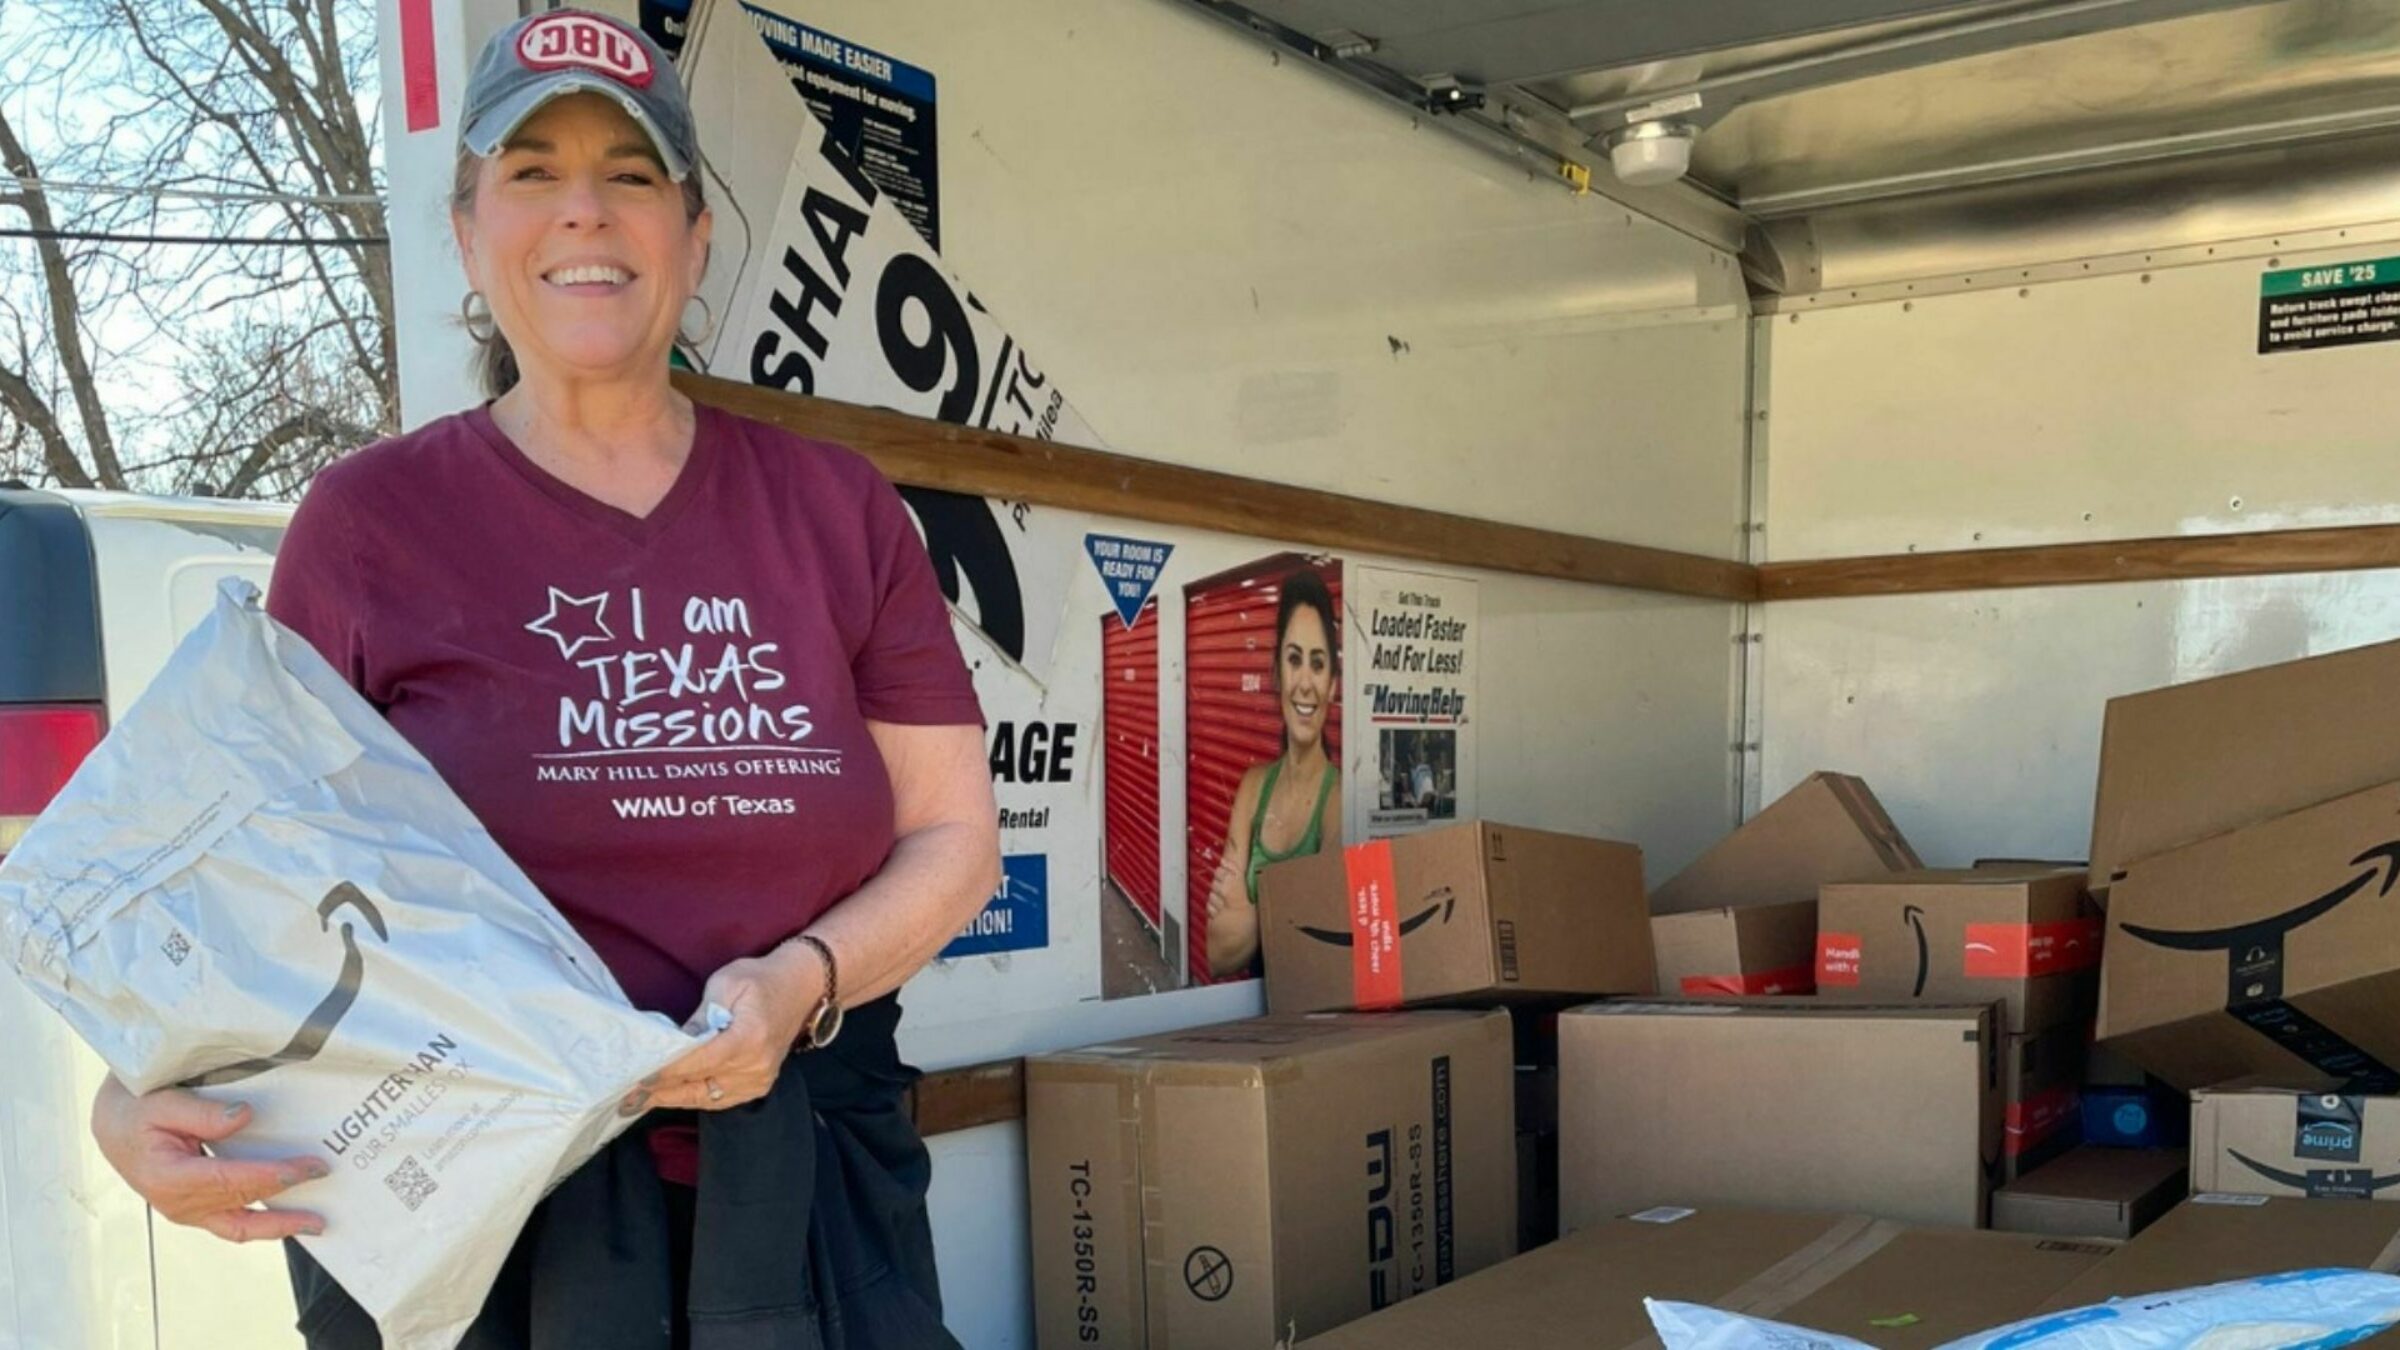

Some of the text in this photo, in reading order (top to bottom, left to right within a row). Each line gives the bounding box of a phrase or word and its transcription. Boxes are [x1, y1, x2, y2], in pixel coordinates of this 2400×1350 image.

[748, 9, 893, 82] OVING MADE EASIER
[862, 85, 879, 106] for
[2301, 267, 2344, 289] SAVE
[2269, 302, 2306, 315] Return
[2308, 297, 2337, 311] truck
[2339, 293, 2373, 307] swept
[2269, 316, 2291, 329] and
[2291, 312, 2340, 327] furniture
[2341, 308, 2369, 323] pads
[2269, 331, 2281, 343] to
[2283, 327, 2313, 341] avoid
[2314, 324, 2355, 338] service
[1093, 539, 1164, 563] YOUR ROOM IS
[1102, 559, 1157, 581] READY FOR
[631, 587, 752, 642] I am
[1370, 608, 1468, 643] Loaded Faster
[1371, 642, 1465, 675] And For Less!
[576, 643, 786, 707] TEXAS
[1372, 683, 1467, 725] MovingHelp
[558, 696, 814, 749] Missions
[536, 757, 842, 782] MARY HILL DAVIS OFFERING
[612, 795, 796, 819] WMU of Texas
[998, 806, 1050, 829] Rental
[1825, 947, 1861, 959] Handl
[322, 1072, 414, 1156] LIGHTER
[352, 1057, 475, 1171] OUR SMALLES OX
[2302, 1133, 2353, 1151] prime
[1068, 1159, 1100, 1345] TC-1350R-SS
